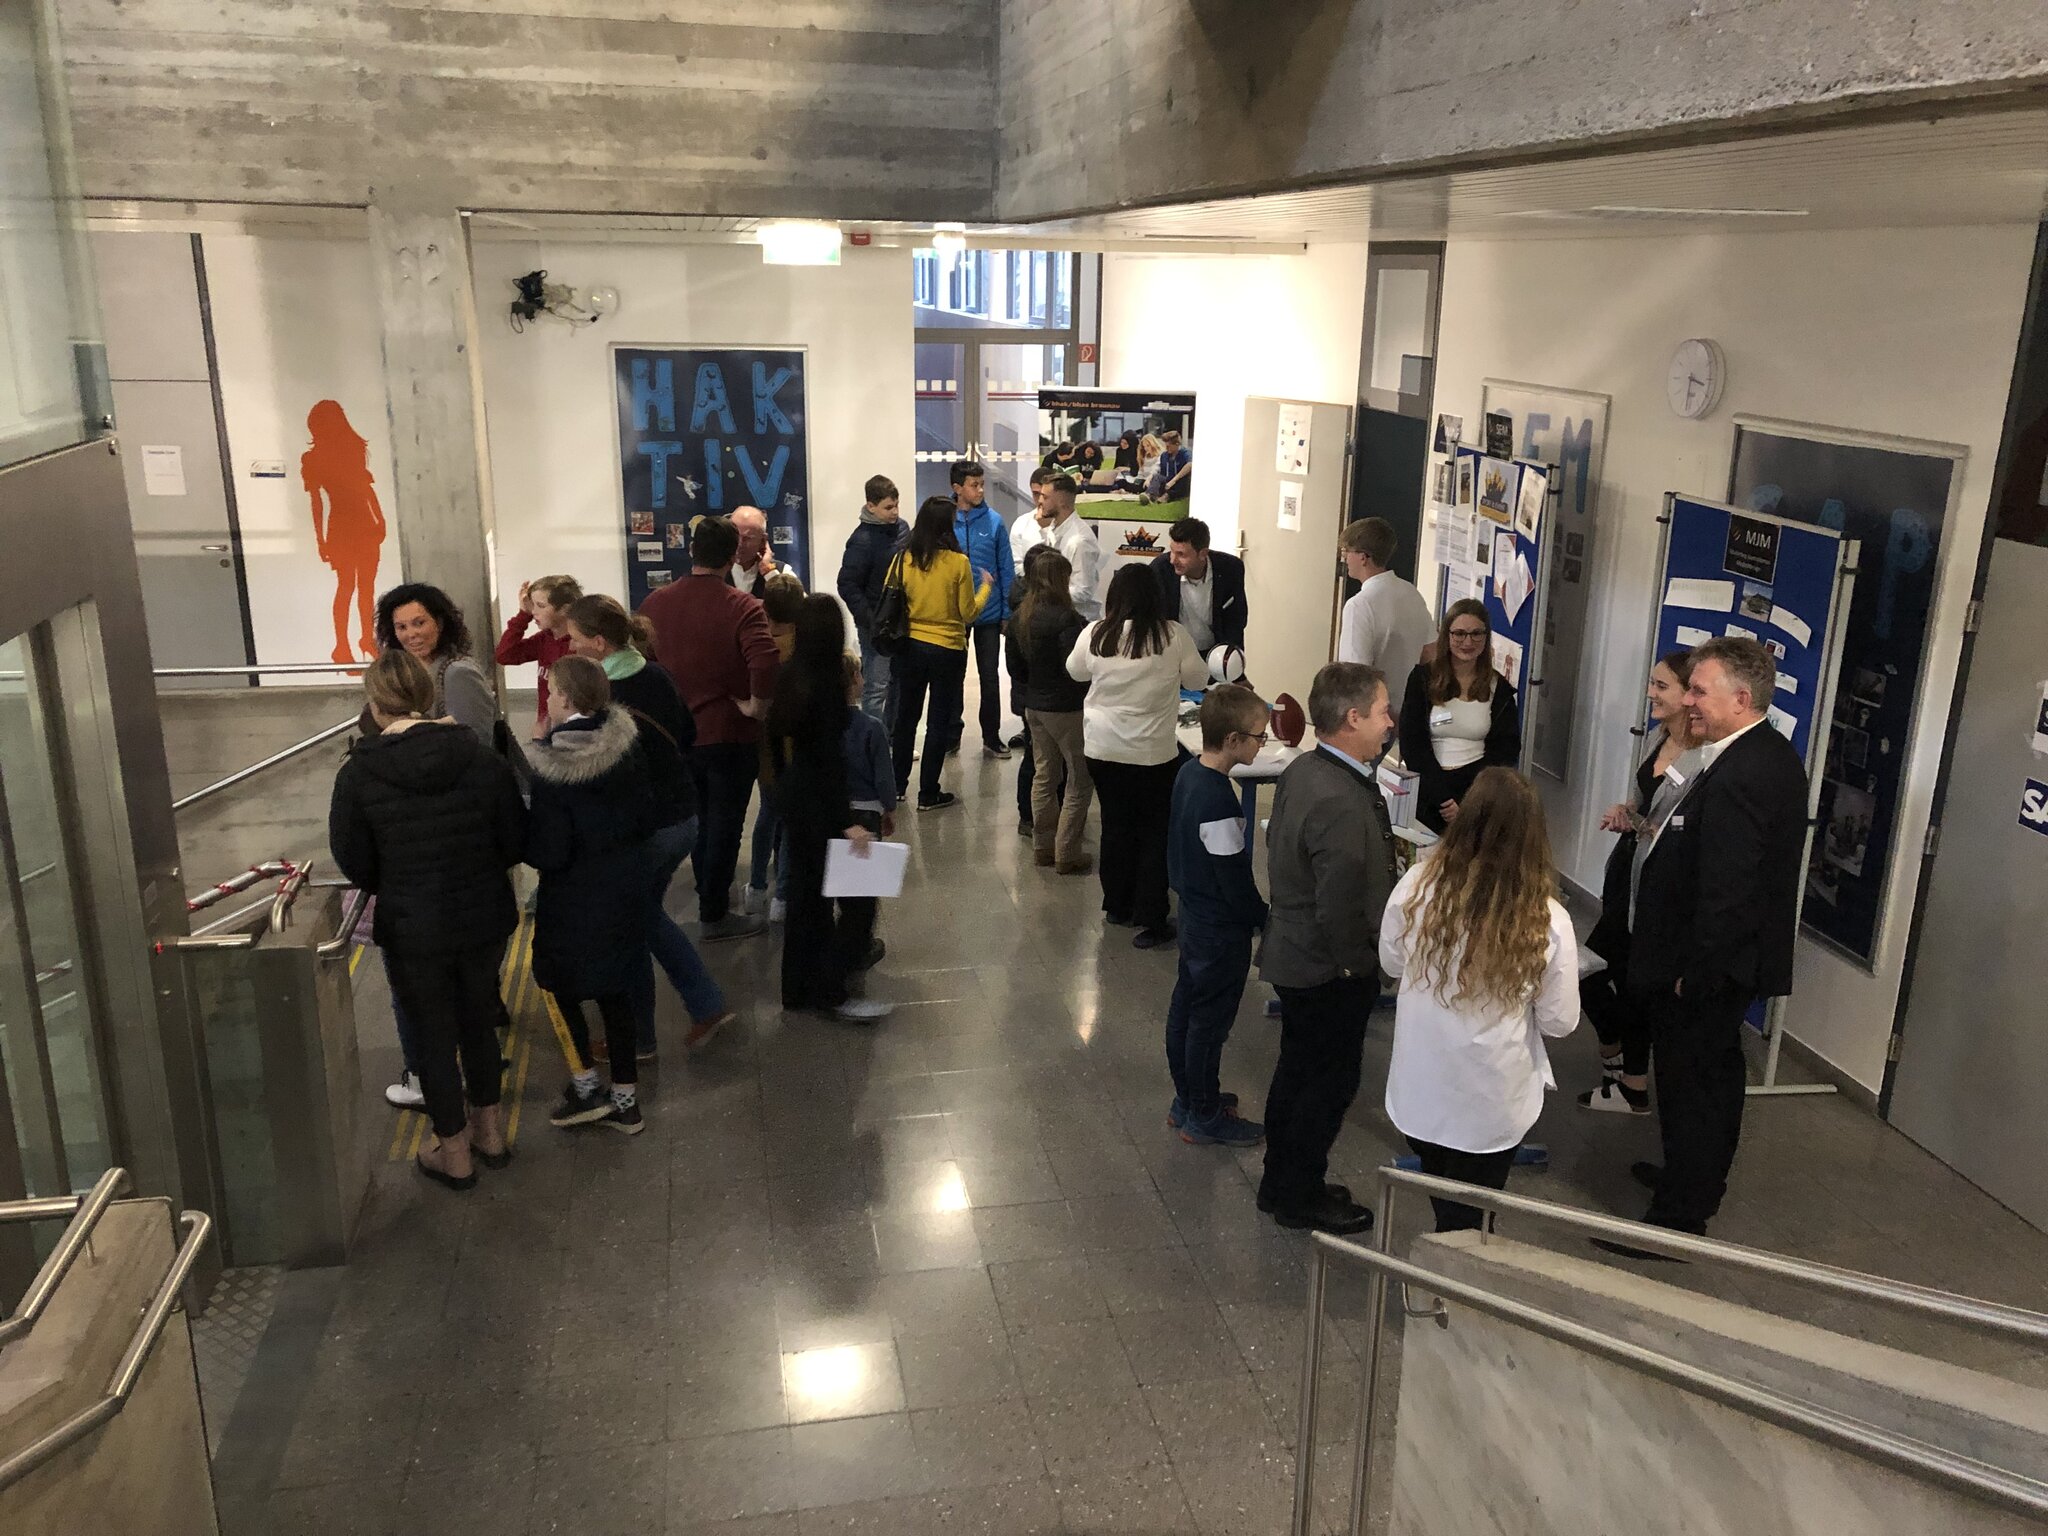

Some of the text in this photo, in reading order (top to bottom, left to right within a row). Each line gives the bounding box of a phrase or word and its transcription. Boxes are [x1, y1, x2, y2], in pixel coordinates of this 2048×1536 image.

[631, 358, 795, 435] HAK
[637, 438, 791, 509] TIV
[1745, 530, 1771, 550] MJM
